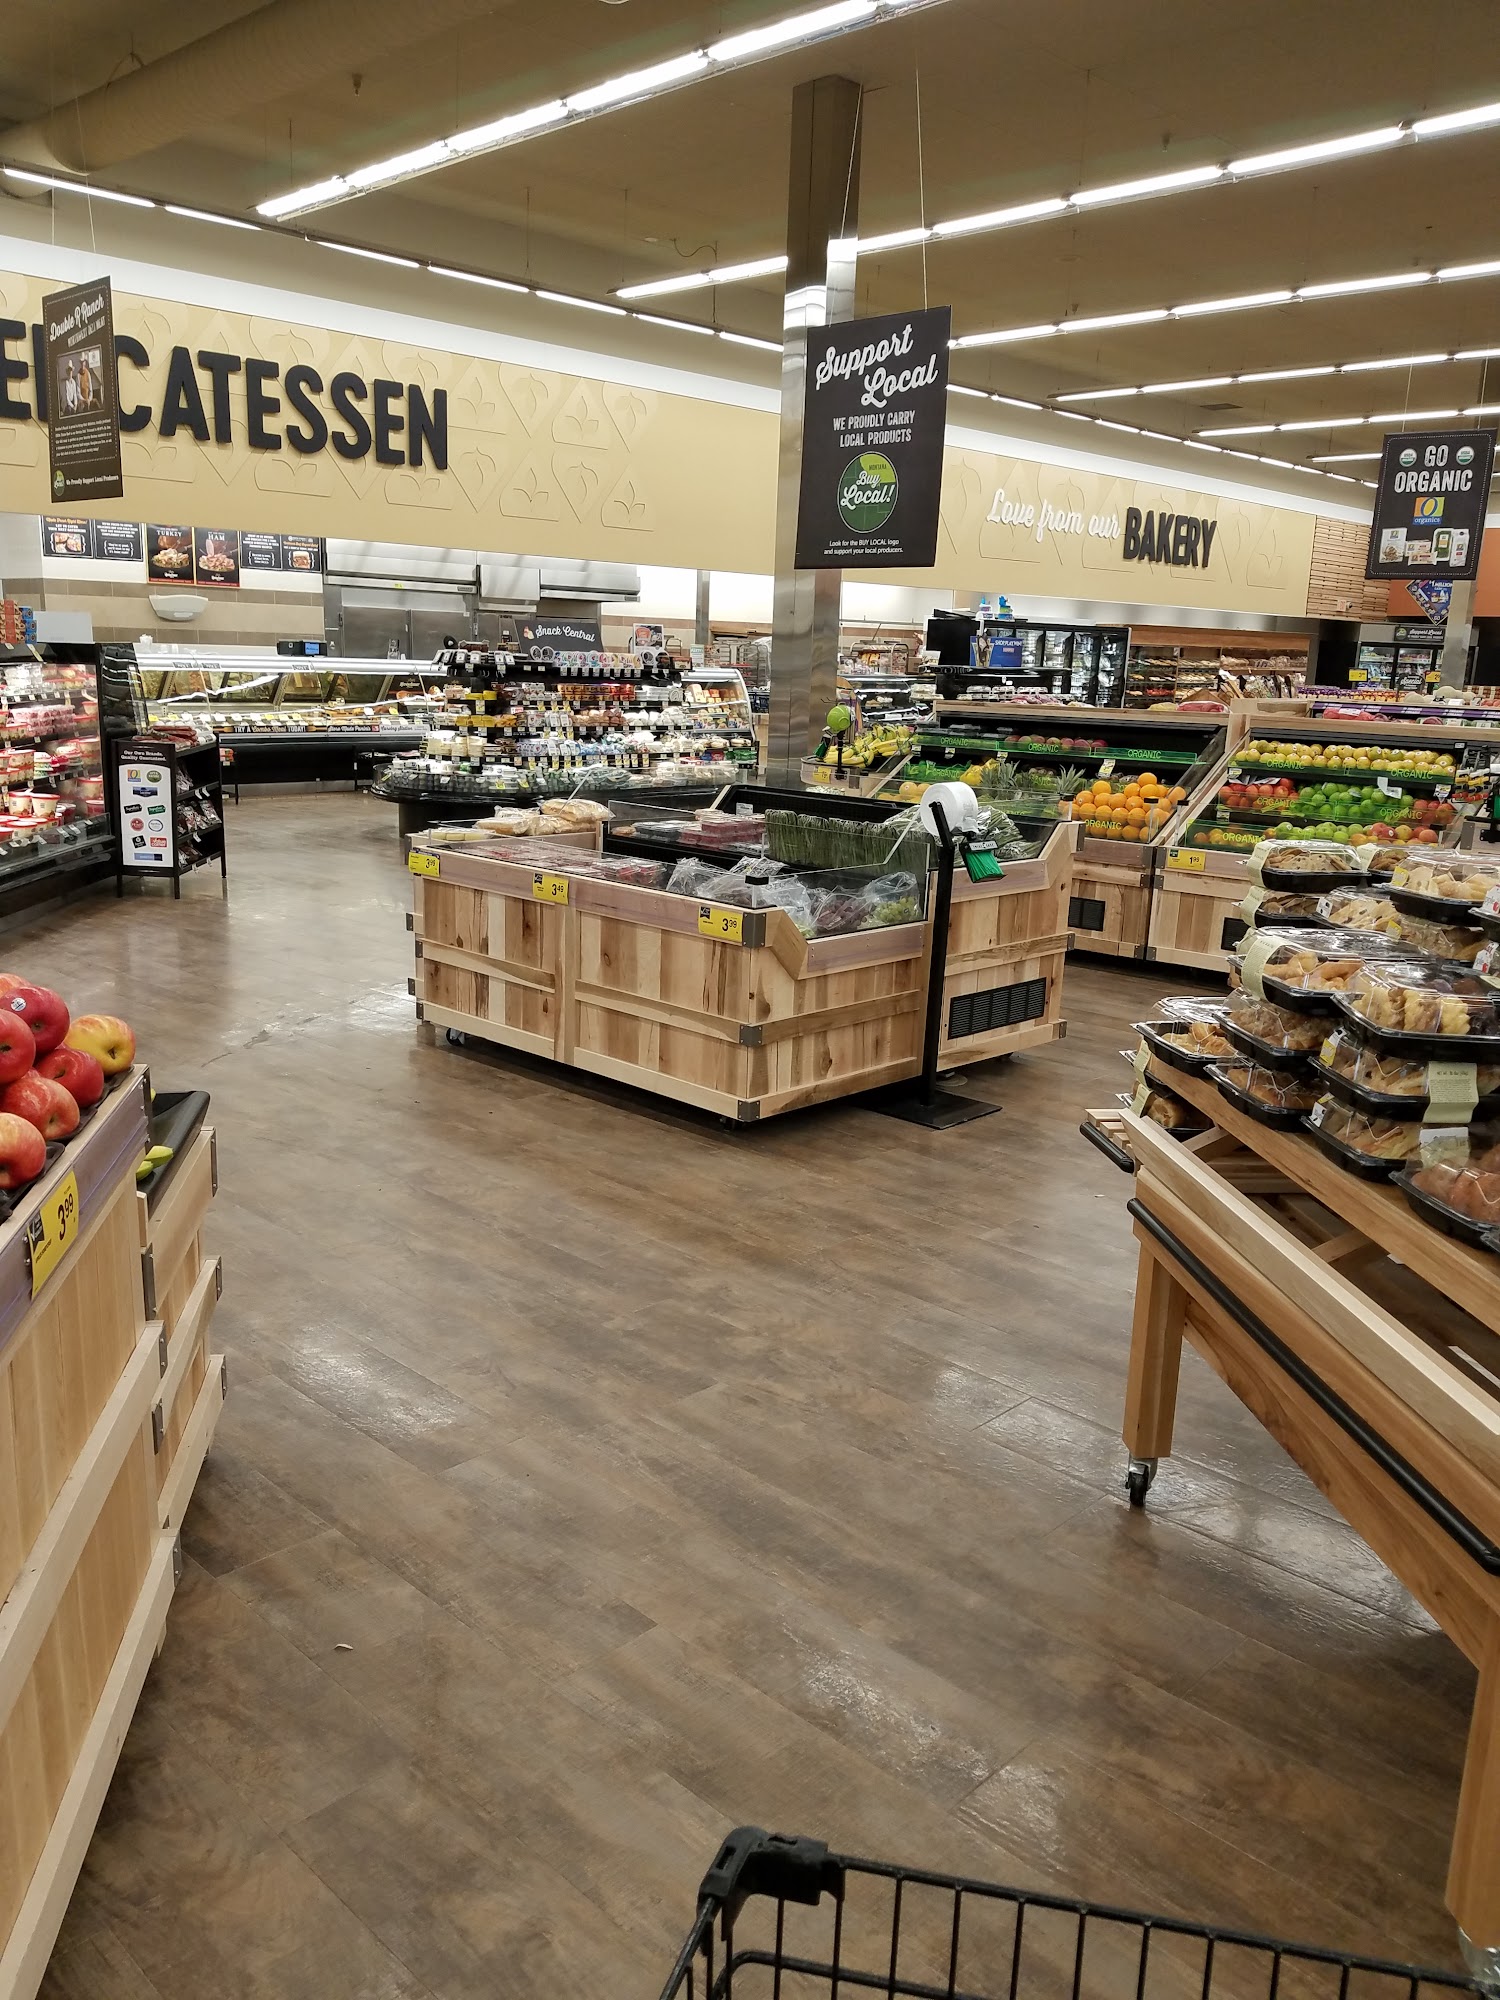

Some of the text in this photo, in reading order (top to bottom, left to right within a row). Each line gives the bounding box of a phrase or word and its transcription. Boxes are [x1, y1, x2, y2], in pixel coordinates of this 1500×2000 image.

[49, 293, 105, 342] Double R Ranch
[816, 323, 914, 391] Support
[860, 354, 939, 409] Local
[833, 410, 916, 431] WE PROUDLY CARRY
[839, 428, 912, 448] LOCAL PRODUCTS
[1424, 444, 1449, 467] GO
[83, 476, 95, 484] Support
[856, 470, 881, 489] Buy
[1394, 469, 1474, 493] ORGANIC
[840, 484, 895, 510] Local!
[986, 488, 1218, 568] Love from our BAKERY
[208, 533, 225, 541] HAM
[887, 539, 899, 547] logo
[834, 548, 852, 556] support
[852, 548, 865, 556] your
[535, 625, 596, 643] Snack Central
[940, 737, 969, 746] ORGANIC
[1028, 743, 1060, 753] ORGANIC
[1127, 749, 1161, 759] ORGANIC
[1266, 759, 1305, 770] ORGANIC
[932, 767, 960, 778] ORGANIC
[1390, 768, 1433, 779] ORGANIC
[1256, 797, 1296, 808] ORGANIC
[1380, 807, 1423, 819] ORGANIC
[1084, 819, 1122, 830] ORGANIC
